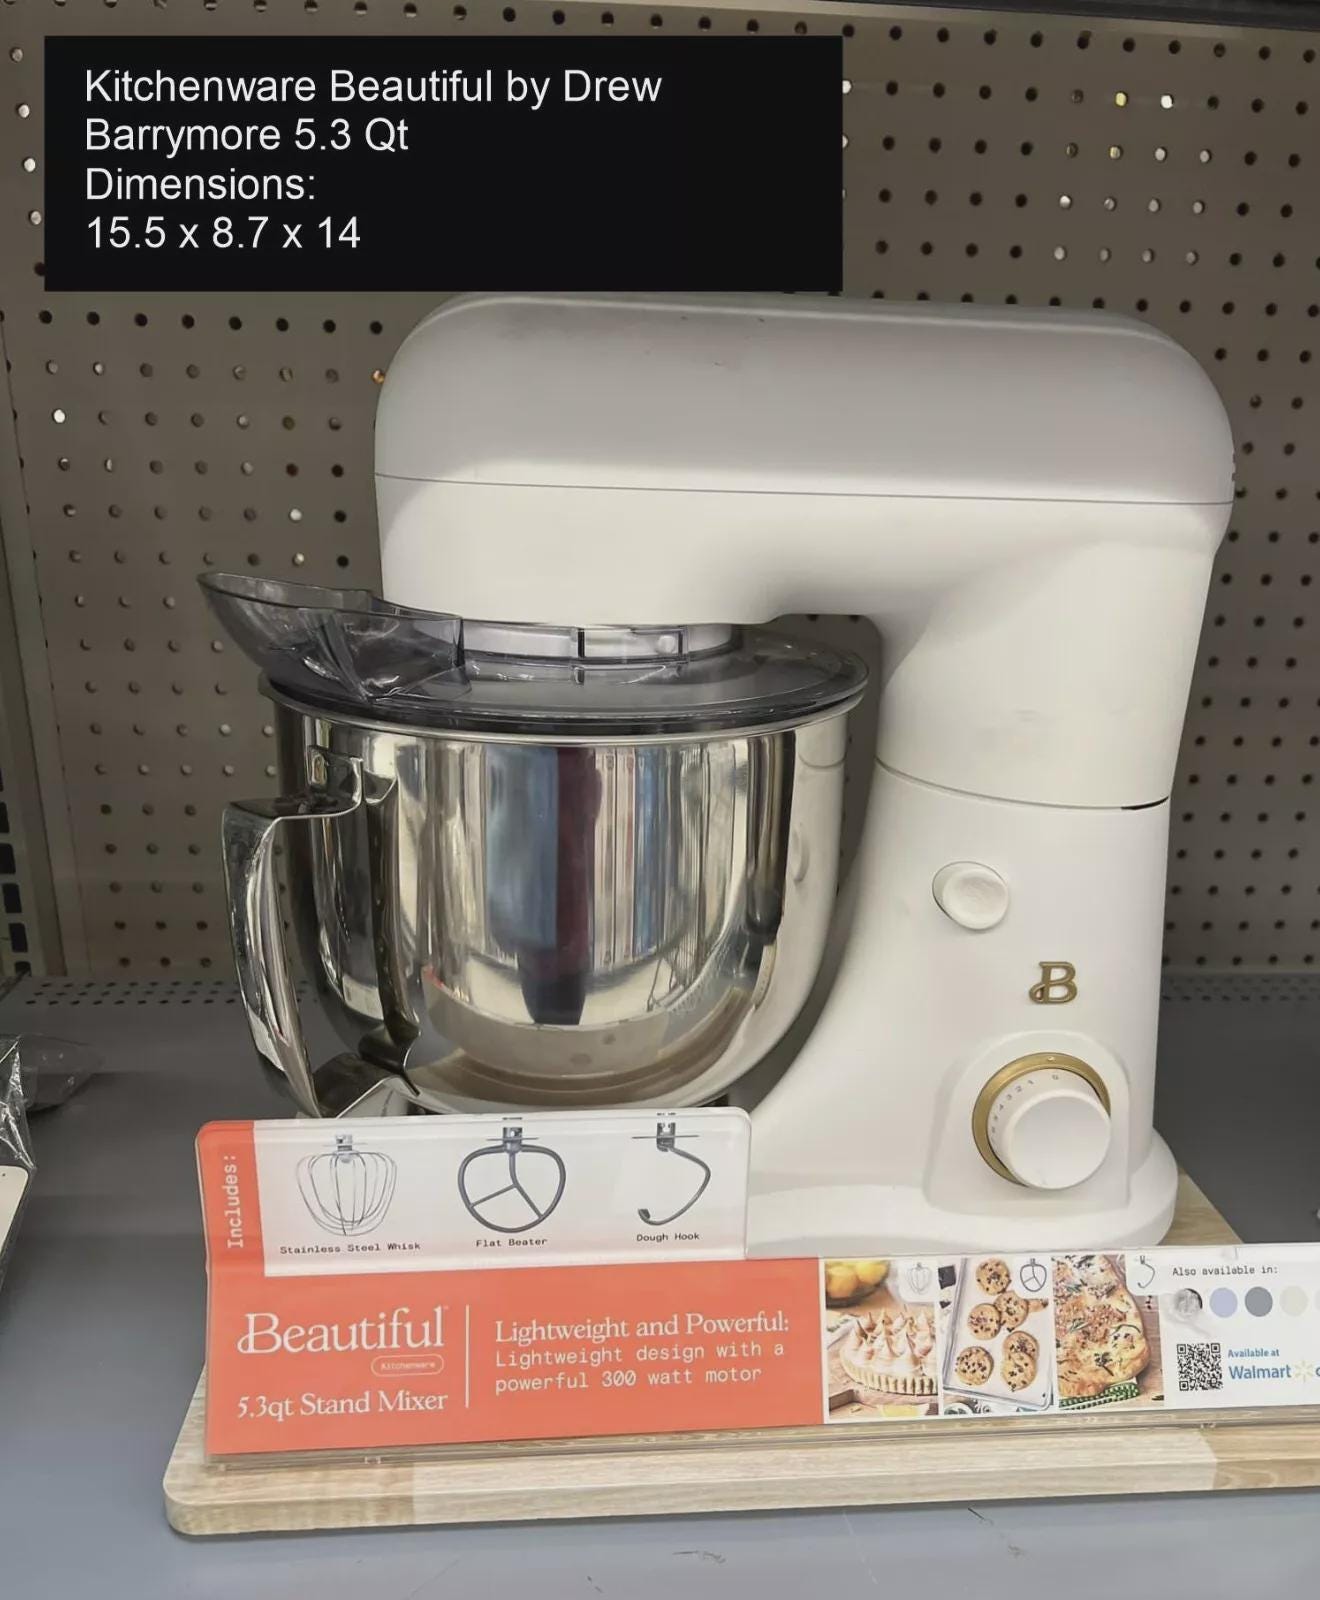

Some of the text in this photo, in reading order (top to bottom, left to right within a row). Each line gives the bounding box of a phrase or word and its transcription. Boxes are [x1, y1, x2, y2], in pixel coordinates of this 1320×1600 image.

[1028, 960, 1078, 1005] B
[222, 1153, 244, 1249] Includes:
[280, 1241, 421, 1255] Stainless Steel Whisk
[476, 1237, 548, 1248] Flat Beater
[636, 1231, 700, 1243] Dough Hook
[1172, 1265, 1279, 1276] Also available in:
[236, 1305, 445, 1354] Beautiful
[495, 1311, 789, 1347] Lightweight and Powerful:
[496, 1341, 785, 1370] Lightweight design with a
[1227, 1348, 1280, 1358] Available at
[495, 1367, 762, 1396] powerful 300 watt motor
[1228, 1364, 1292, 1380] Walmart
[237, 1389, 448, 1422] 5.3qt Stand Mixer
